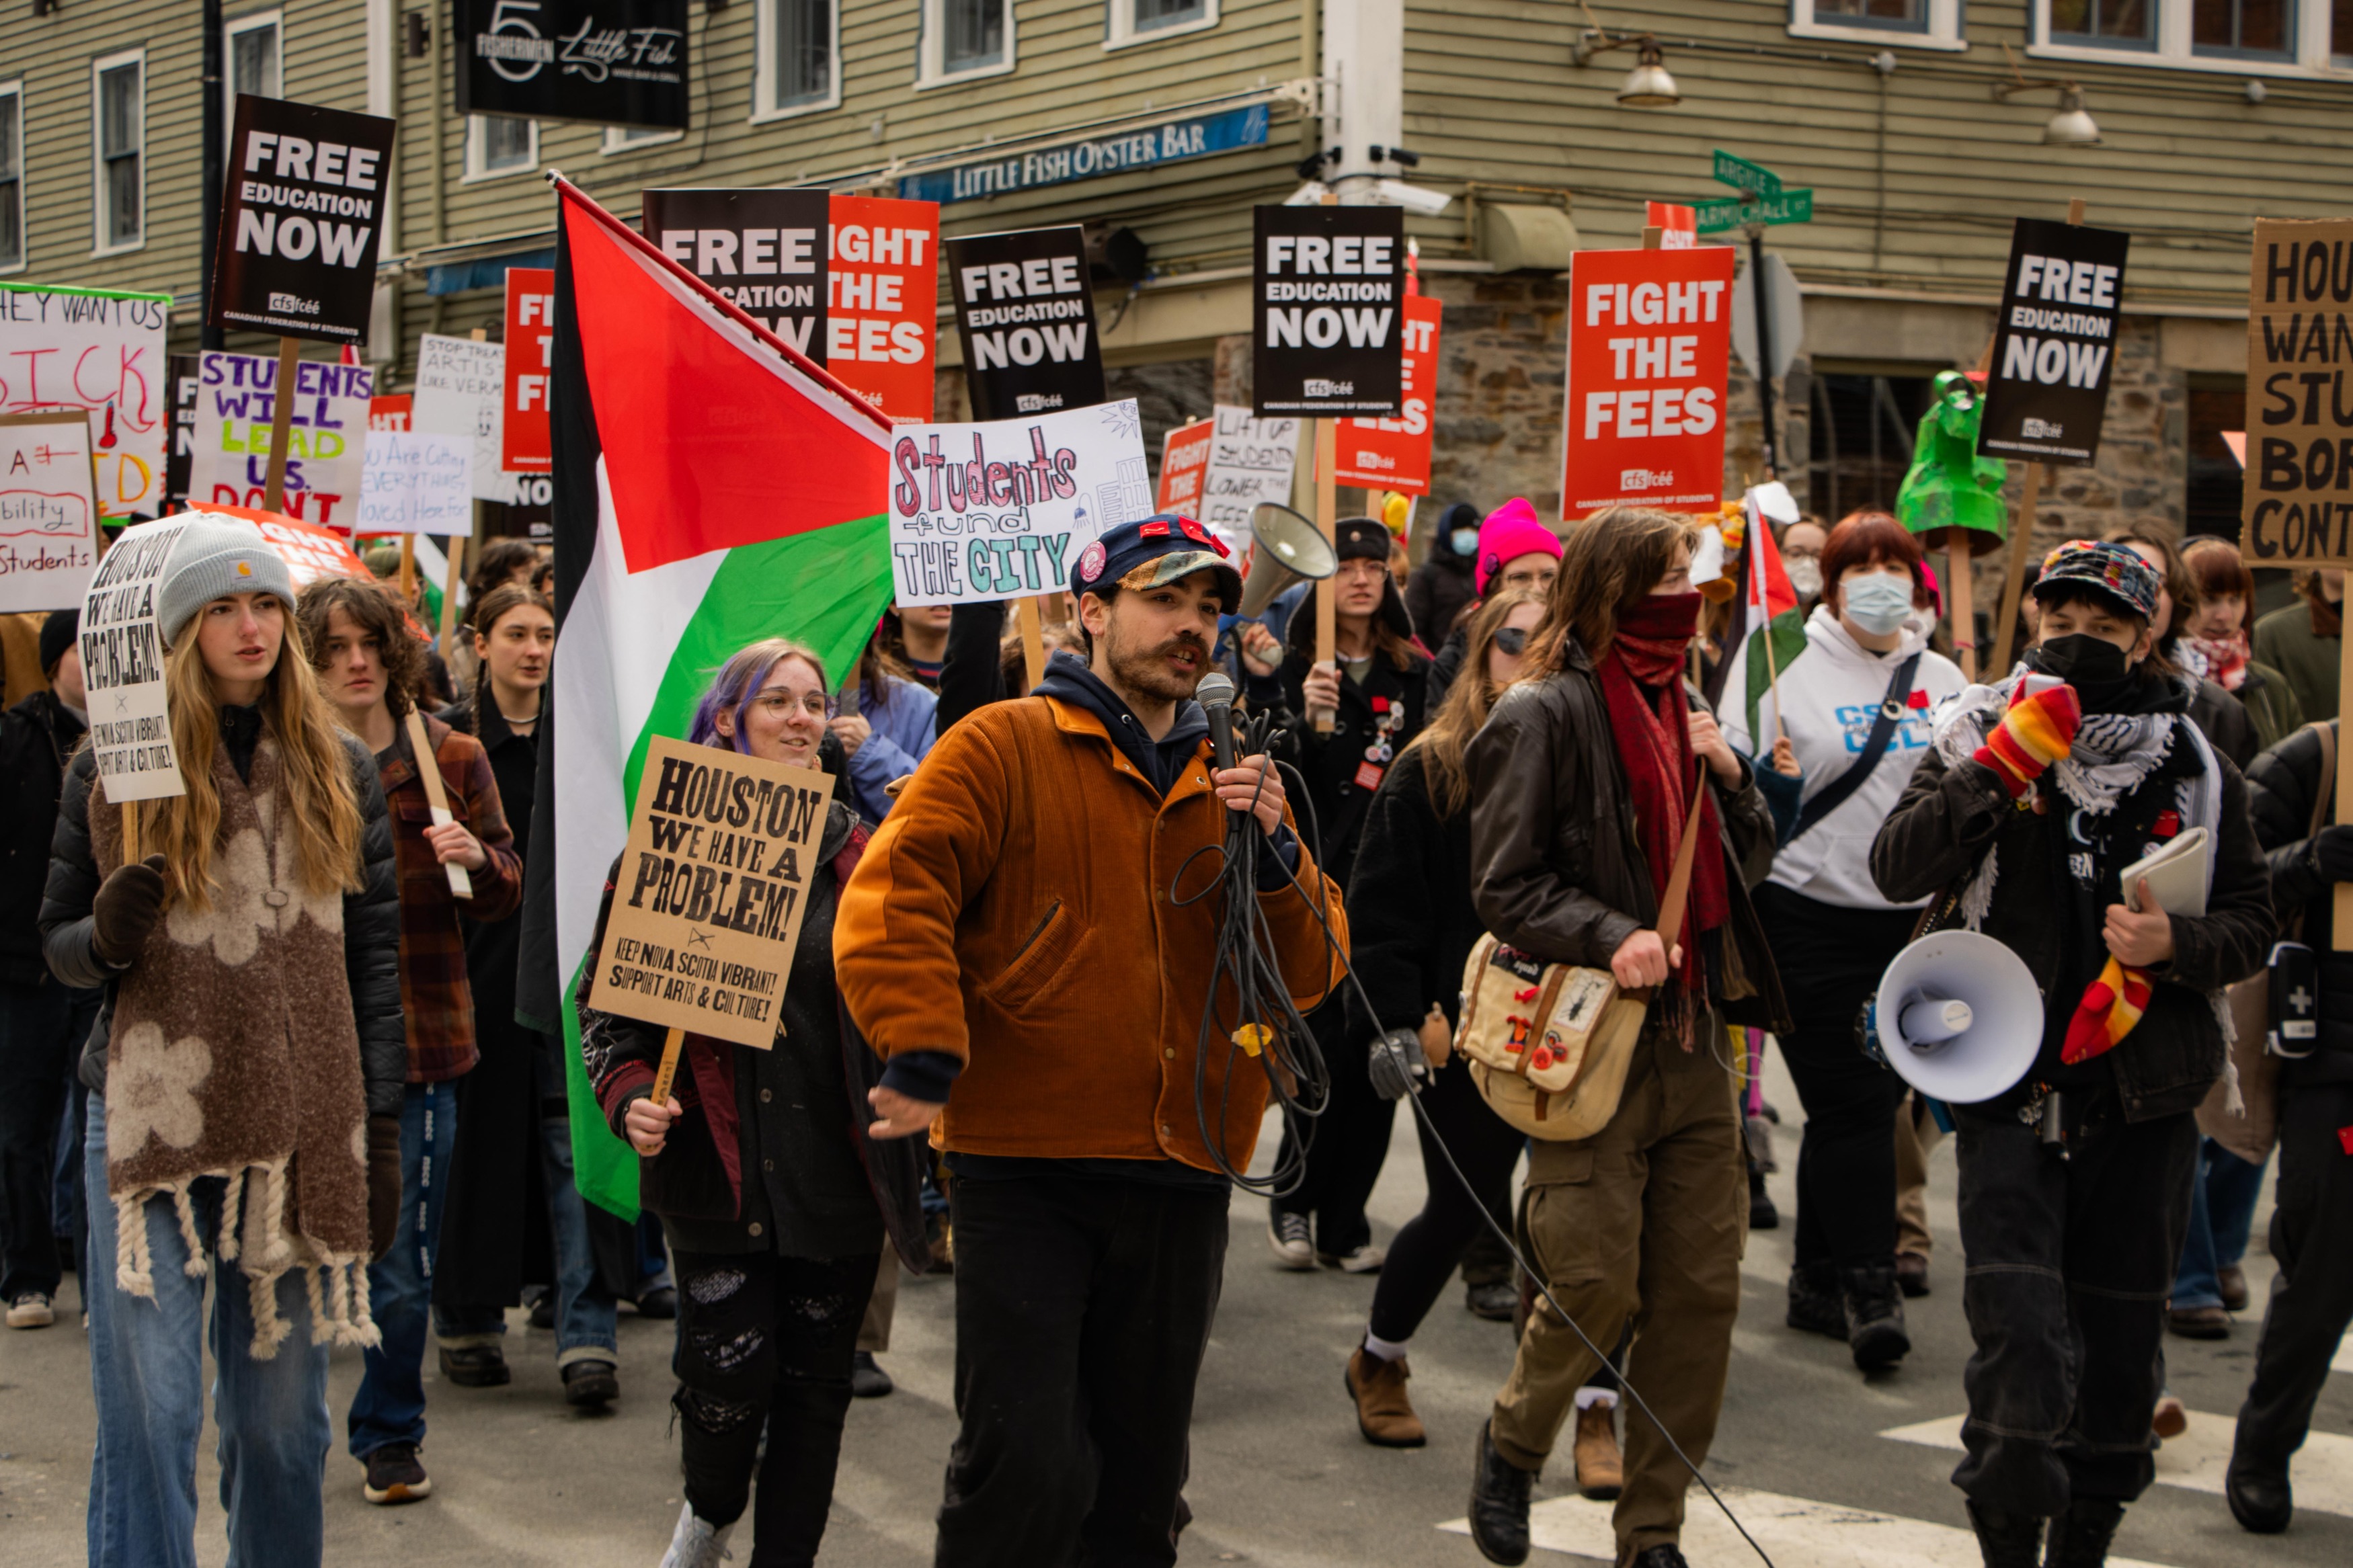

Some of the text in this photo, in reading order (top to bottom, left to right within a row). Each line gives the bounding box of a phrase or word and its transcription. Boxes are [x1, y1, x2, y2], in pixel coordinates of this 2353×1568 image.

[477, 33, 555, 63] FISHERMEN
[557, 15, 682, 83] Little Fish
[245, 130, 381, 191] FREE
[953, 123, 1207, 200] LITTLE FISH OYSTER BAR
[1718, 158, 1767, 194] ARGYLE
[241, 181, 372, 219] EDUCATION
[1698, 200, 1791, 225] ARMICHAEL
[235, 208, 371, 269] NOW
[662, 229, 815, 276] FREE
[828, 224, 930, 266] GHT
[1267, 237, 1393, 274] FREE
[716, 286, 813, 307] CATION
[961, 256, 1082, 302] FREE
[1266, 282, 1392, 301] EDUCATION
[2016, 253, 2118, 308] FREE
[131, 300, 162, 330] US
[223, 311, 359, 336] CANADIAN FEDERATION OF STUDENTS
[967, 300, 1084, 327] EDUCATION
[1587, 280, 1724, 327] FIGHT
[2010, 306, 2111, 338] EDUCATION
[427, 339, 464, 354] STOP
[827, 317, 926, 364] EES
[971, 323, 1087, 370] NOW
[1267, 307, 1393, 348] NOW
[202, 354, 372, 400] STUENTS
[426, 354, 504, 376] ARTIS
[1608, 335, 1698, 380] THE
[2001, 334, 2108, 388] NOW
[422, 373, 450, 390] LIKE
[1585, 386, 1717, 440] FEES
[895, 425, 1076, 518] Students
[1166, 438, 1210, 475] FIGHT
[1168, 470, 1199, 503] THE
[904, 506, 1031, 536] fund
[894, 540, 963, 597] THE
[968, 532, 1072, 593] CITY
[87, 583, 153, 628] WE HAVE A
[82, 622, 160, 692] PROBLEM!
[648, 815, 801, 884] WE HAVE A
[628, 852, 798, 942] PROBLEM!
[614, 937, 778, 996] KEEP NOVA SCOTIA VIBRANT!
[608, 964, 771, 1023] SUPPORT ARTS & CULTURE!
